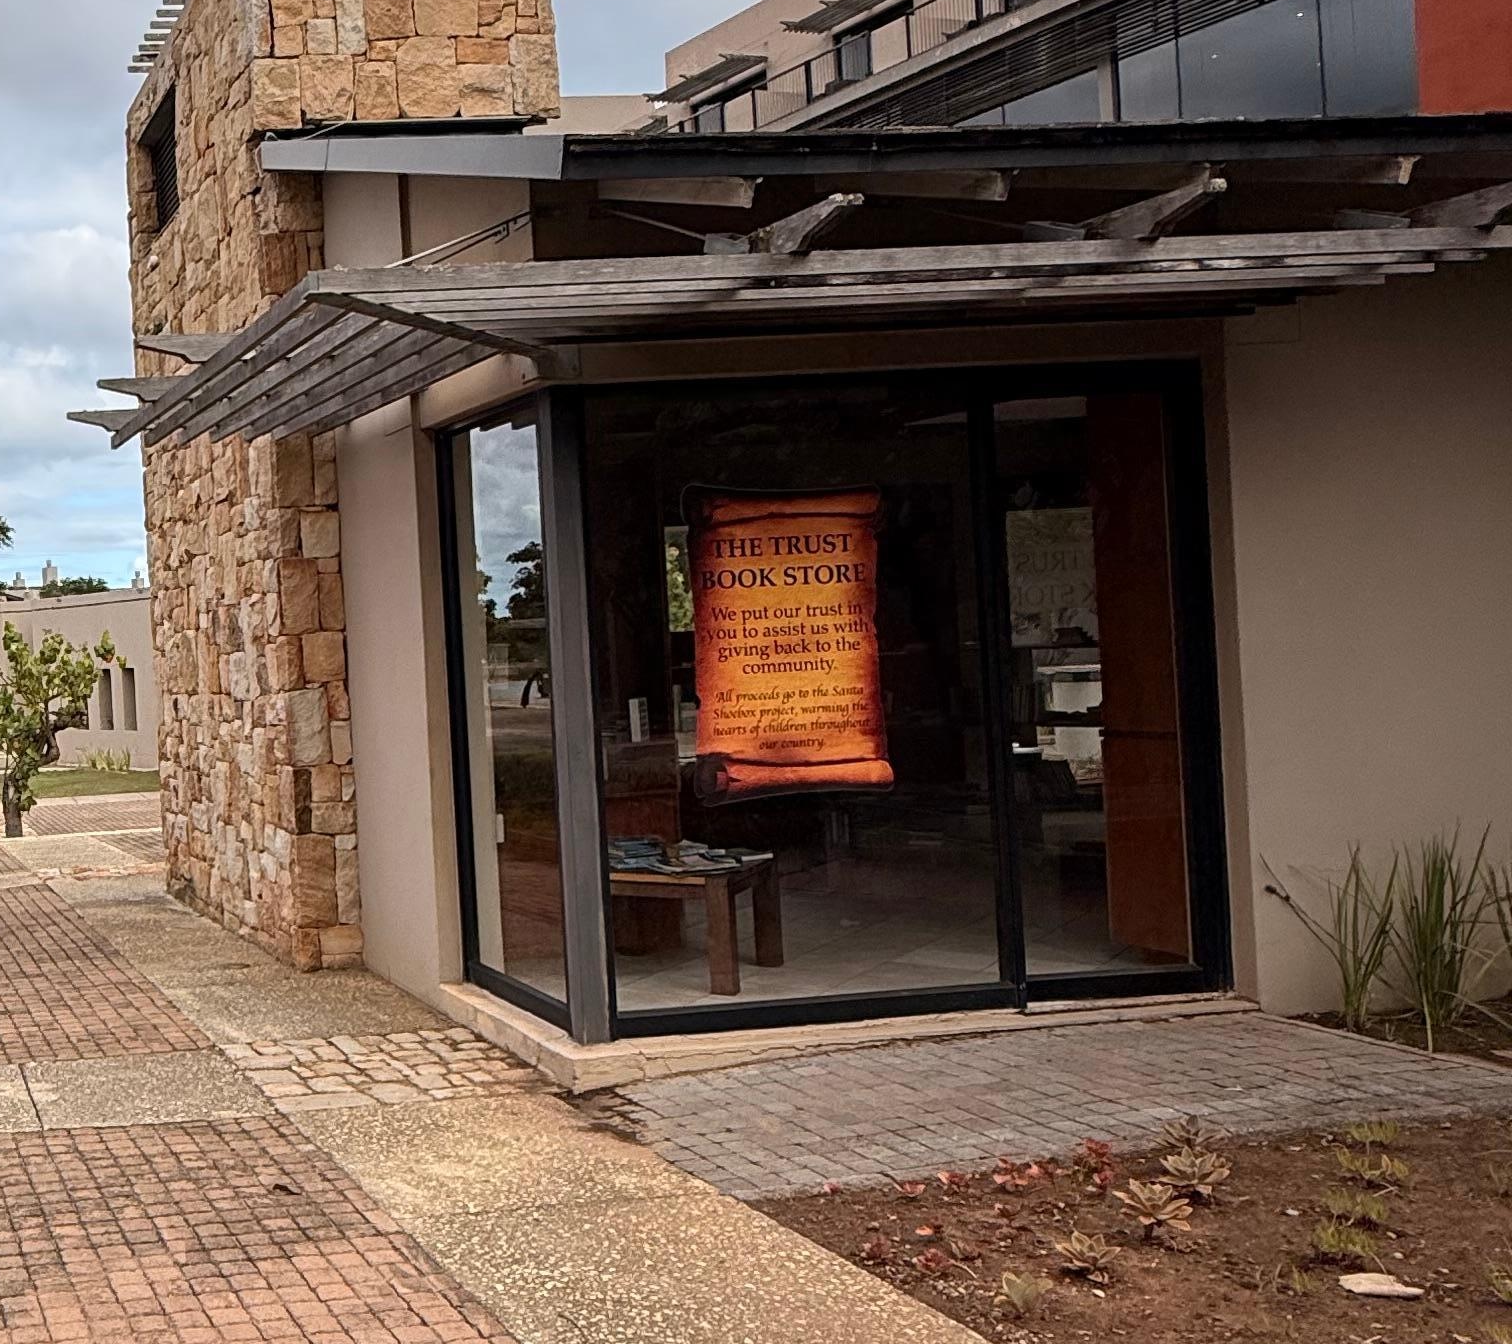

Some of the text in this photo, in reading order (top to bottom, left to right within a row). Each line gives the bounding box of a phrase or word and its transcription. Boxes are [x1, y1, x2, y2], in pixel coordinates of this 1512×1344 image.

[712, 534, 852, 558] THE TRUST
[701, 563, 866, 590] BOOK STORE
[711, 601, 862, 625] We put our trust in
[706, 618, 869, 644] you to assist us with
[718, 637, 861, 663] giving back to the
[742, 657, 837, 675] community.
[735, 686, 780, 706] proceeds
[782, 689, 796, 704] go
[798, 687, 809, 698] to
[812, 684, 829, 697] the
[832, 684, 864, 697] Santa
[713, 699, 869, 723] Shoebox project, warming the
[713, 716, 871, 738] hearts of children throughout
[759, 739, 777, 751] our
